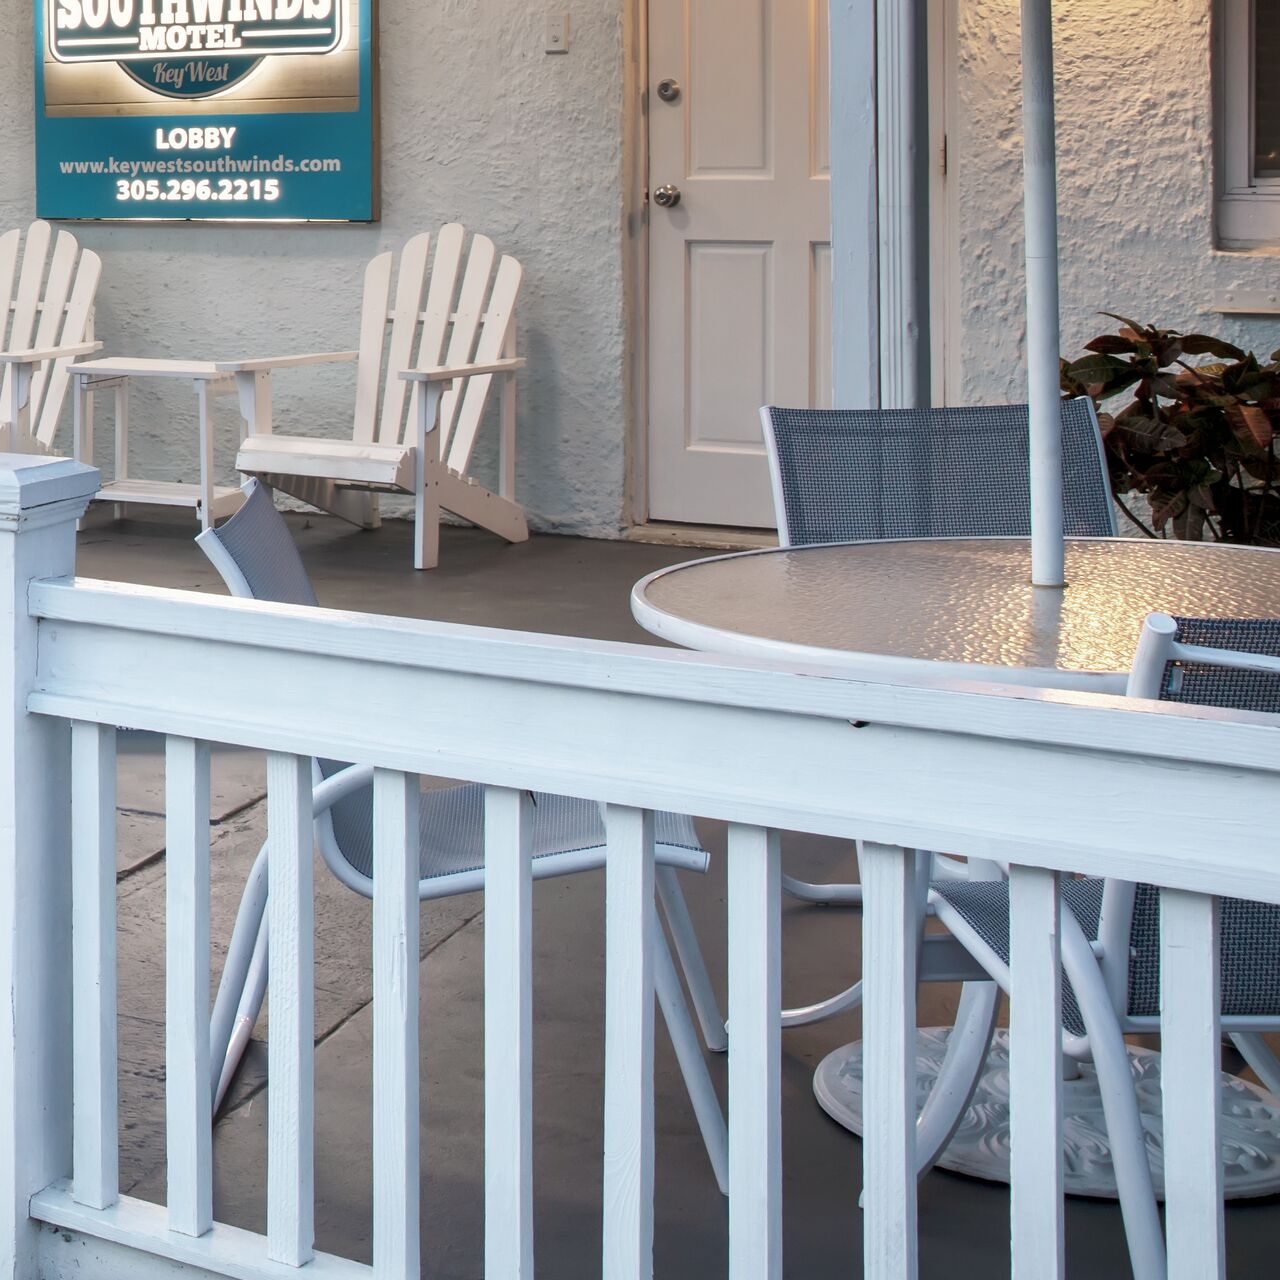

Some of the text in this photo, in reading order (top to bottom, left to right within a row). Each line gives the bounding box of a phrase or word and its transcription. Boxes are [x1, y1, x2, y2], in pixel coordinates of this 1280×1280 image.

[139, 24, 242, 51] MOTEL
[152, 61, 229, 89] Key West
[155, 127, 236, 150] LOBBY
[59, 154, 341, 177] www.keywestsouthwinds.com
[115, 179, 280, 201] 305.296.2215
